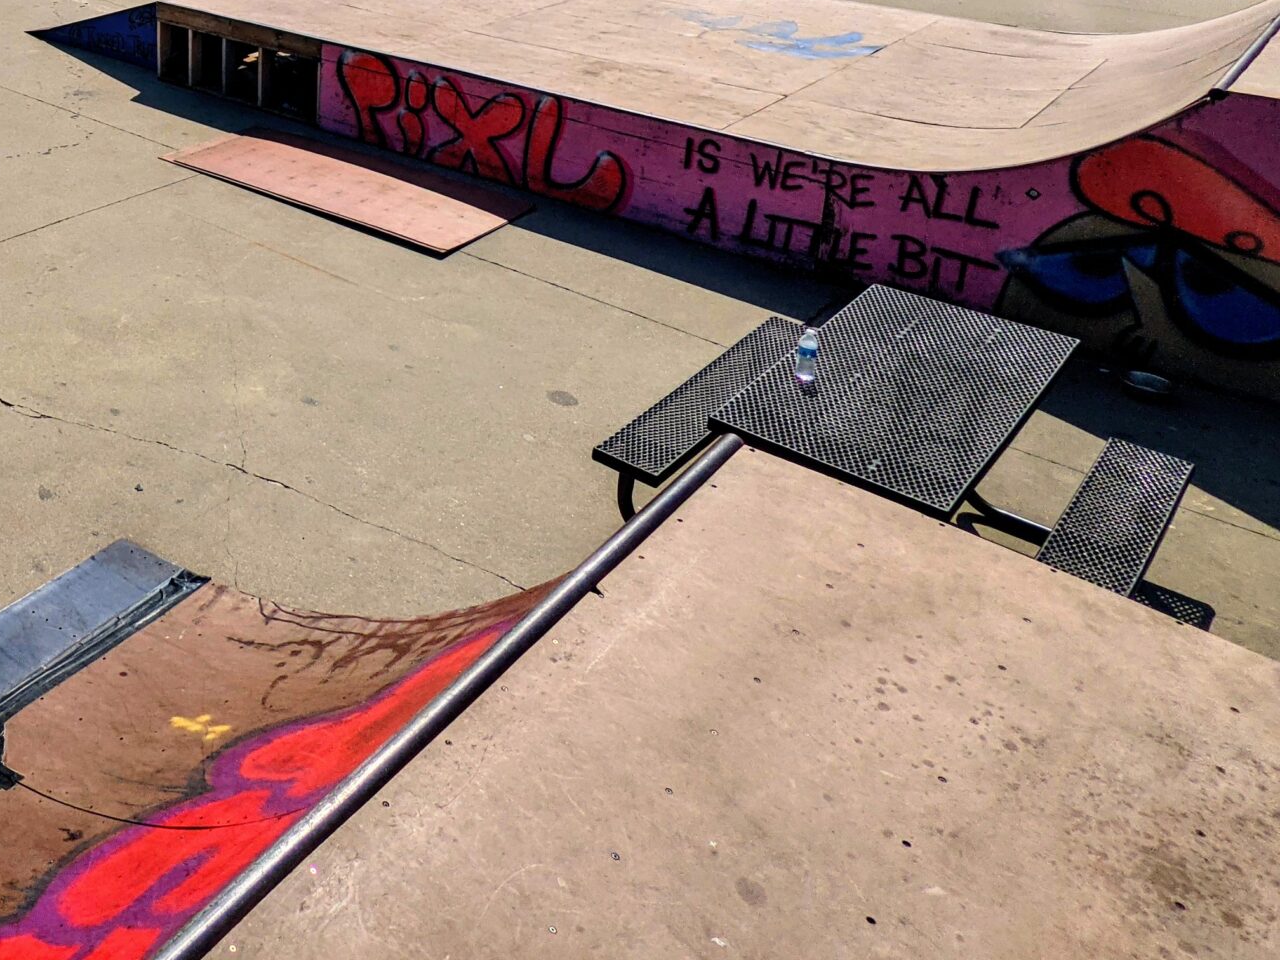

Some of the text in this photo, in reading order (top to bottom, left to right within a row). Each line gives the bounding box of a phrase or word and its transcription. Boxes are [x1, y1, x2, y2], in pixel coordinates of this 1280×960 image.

[683, 137, 999, 229] IS WE'RE ALL
[683, 186, 718, 242] A
[888, 234, 999, 294] BIT
